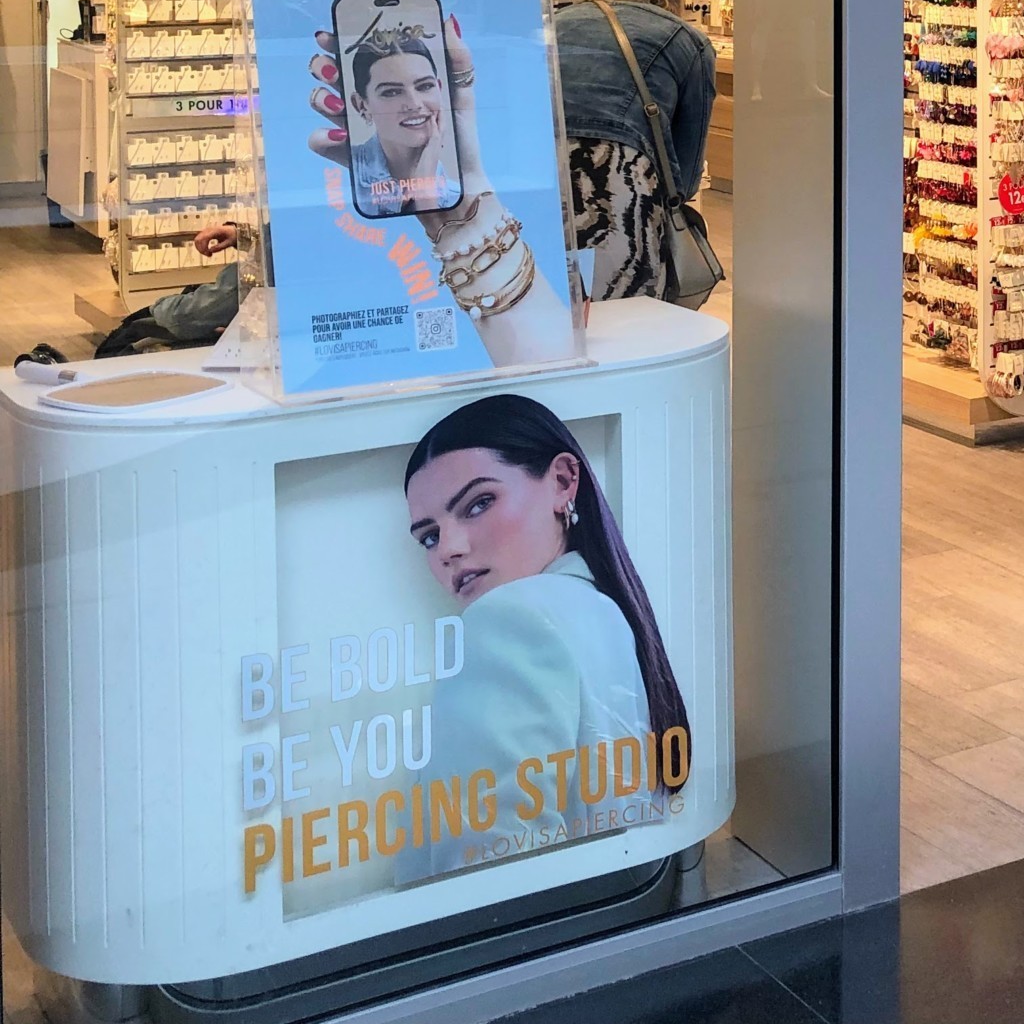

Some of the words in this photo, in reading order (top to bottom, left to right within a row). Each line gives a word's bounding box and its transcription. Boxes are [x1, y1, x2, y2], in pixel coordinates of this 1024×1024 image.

[344, 10, 437, 56] Lovisa
[176, 101, 183, 112] 3
[188, 100, 223, 111] POUR
[370, 180, 397, 196] JUST
[334, 211, 388, 247] SHARE
[388, 232, 439, 305] WIN!
[311, 310, 366, 324] PHOTOGRAPHIEZ
[367, 309, 376, 318] ET
[377, 305, 409, 317] PARTAGEZ
[312, 322, 331, 334] POUR
[332, 321, 352, 333] AVOIR
[353, 319, 366, 329] UNE
[368, 317, 394, 328] CHANCE
[395, 315, 404, 324] DE
[240, 643, 311, 722] BE
[329, 615, 465, 703] BOLD
[241, 732, 311, 812] BE
[329, 704, 432, 788] YOU
[243, 769, 497, 894] PIERCING
[516, 725, 690, 822] STUDIO
